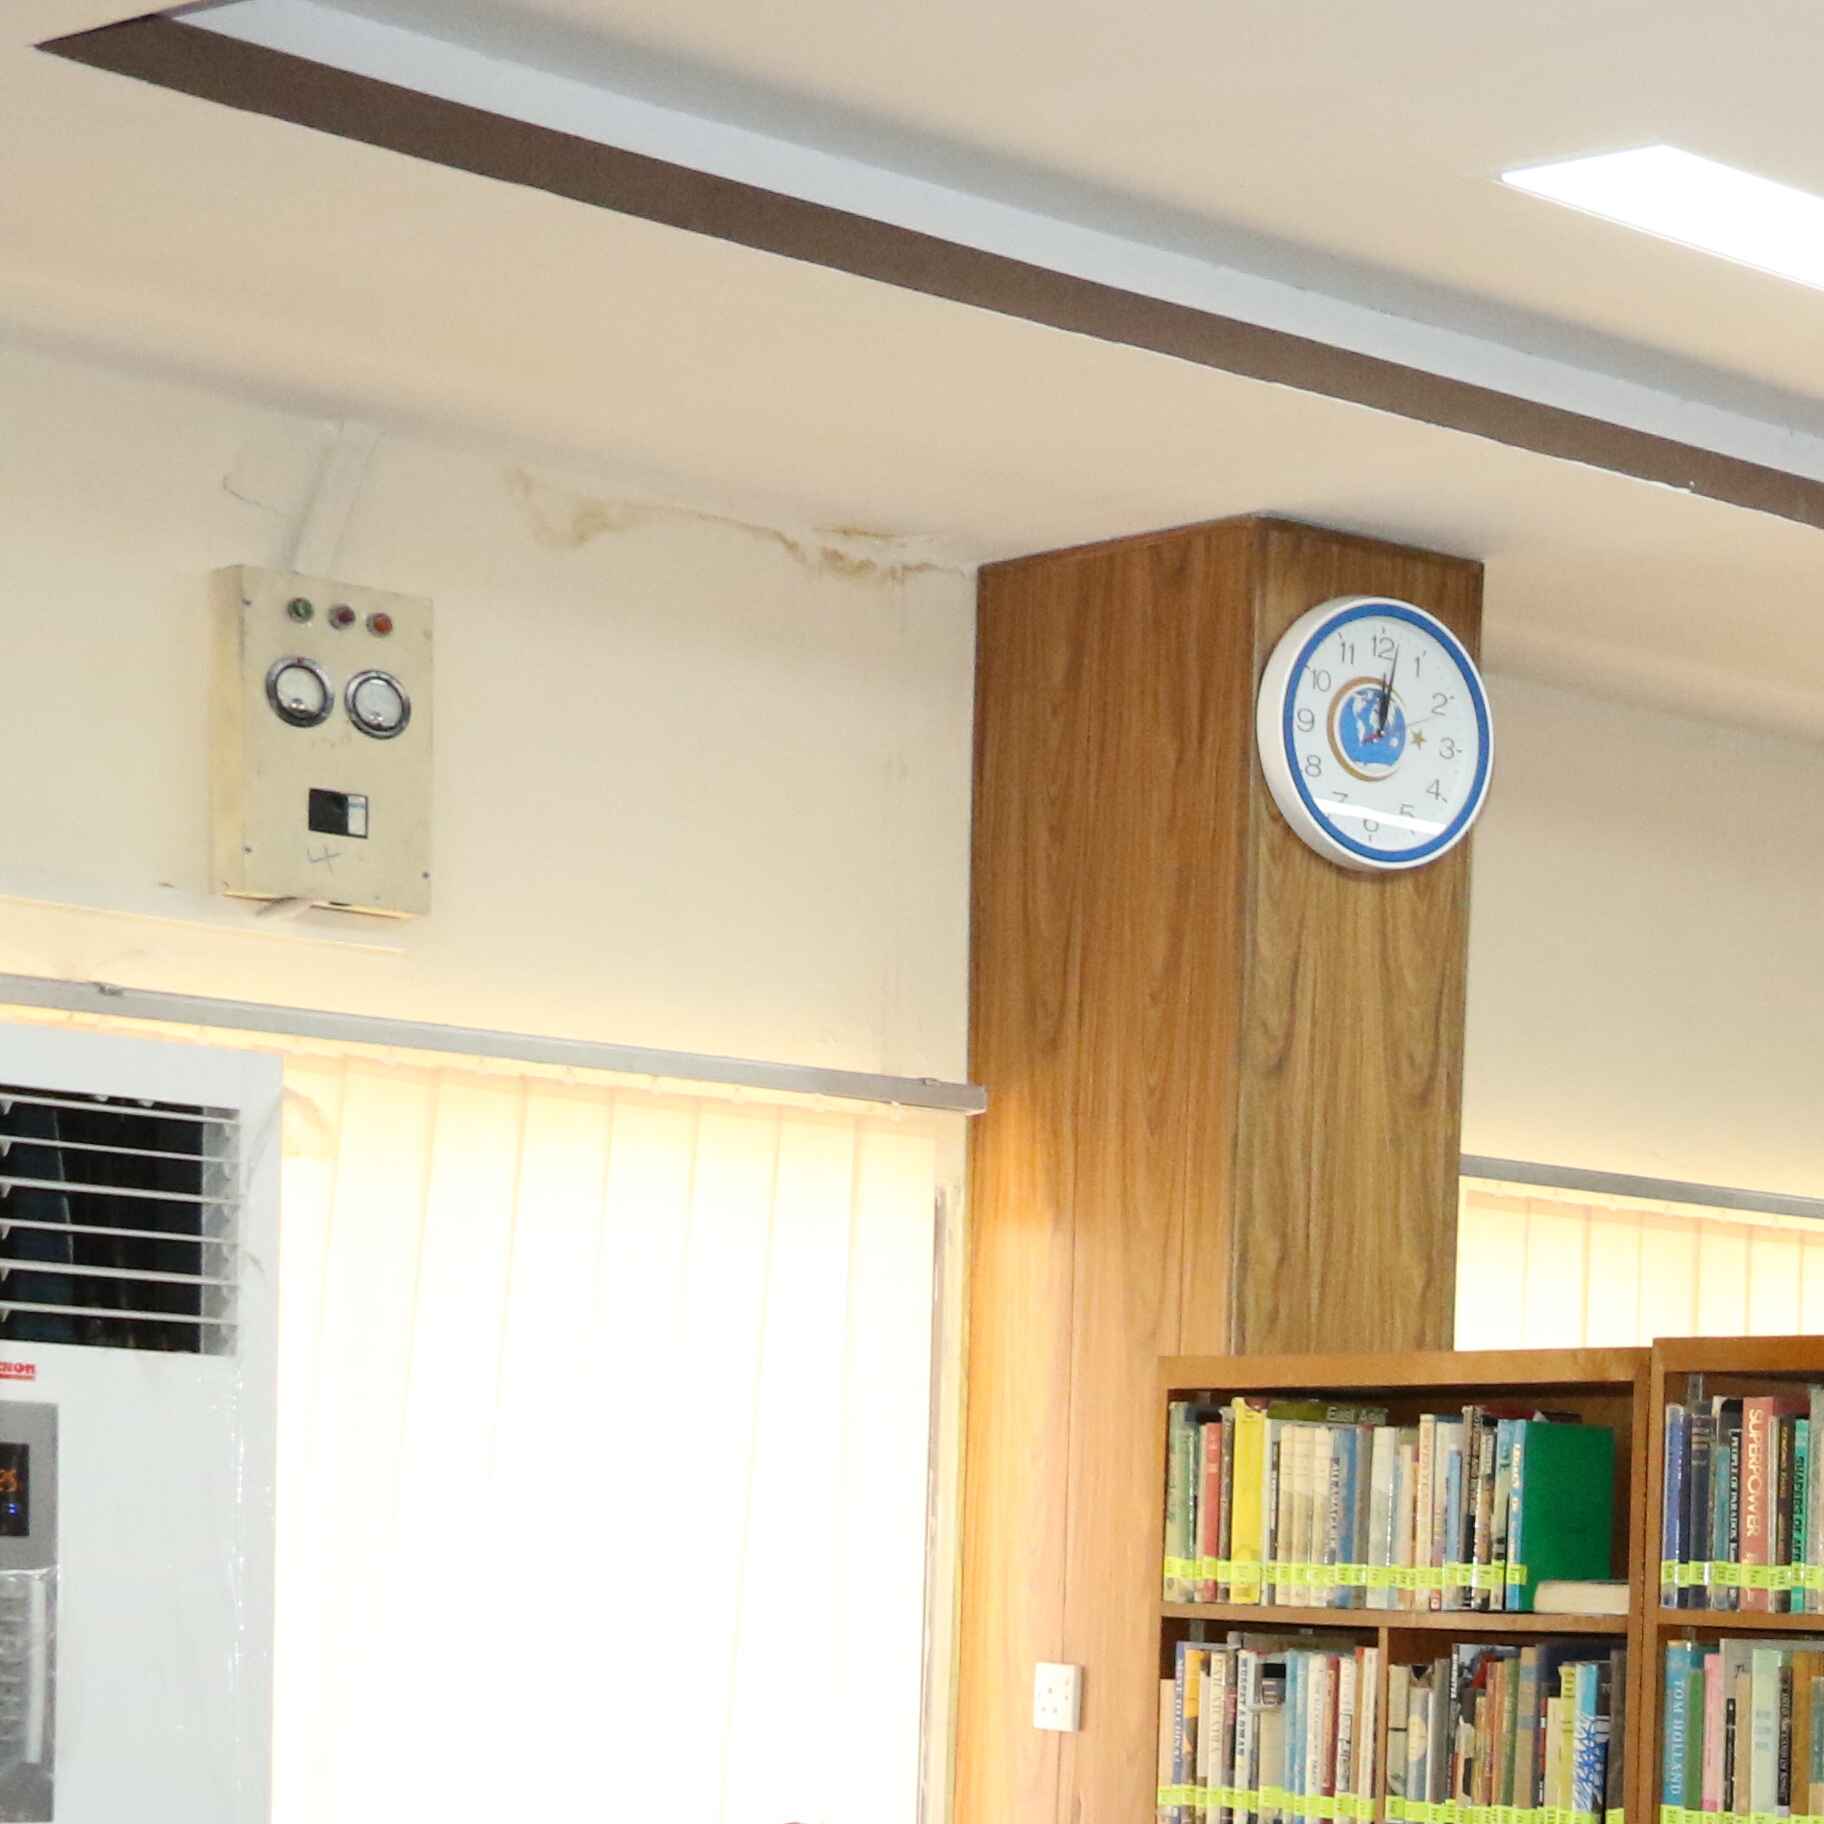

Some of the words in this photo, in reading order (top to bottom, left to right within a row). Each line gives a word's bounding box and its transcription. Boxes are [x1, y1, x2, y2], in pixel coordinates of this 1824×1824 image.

[1340, 642, 1355, 665] 11
[1372, 636, 1394, 660] 12
[1414, 656, 1421, 678] 1
[1312, 669, 1331, 692] 10
[1432, 693, 1448, 716] 2
[1296, 708, 1315, 732] 9
[1440, 738, 1456, 759] 3
[1304, 755, 1322, 777] 8
[1427, 779, 1442, 798] 4
[1746, 1408, 1765, 1536] SUPERPOWER
[1671, 1679, 1685, 1713] TOM
[1669, 1718, 1683, 1795] HOLLAND
